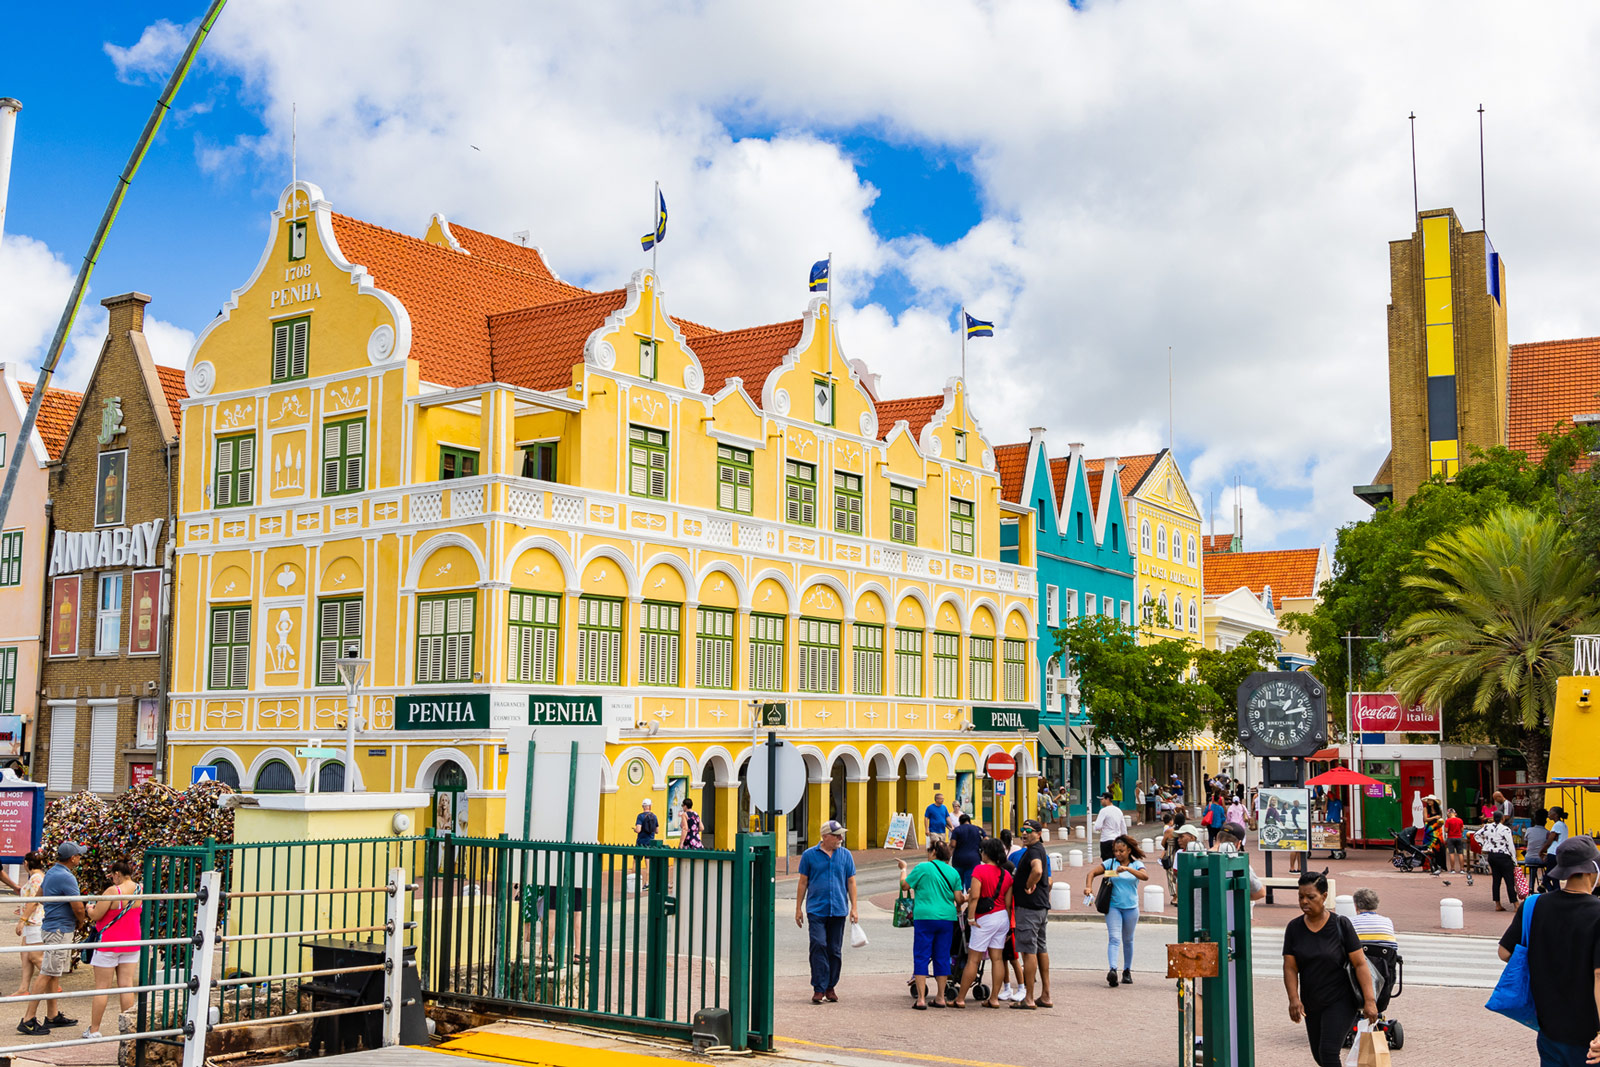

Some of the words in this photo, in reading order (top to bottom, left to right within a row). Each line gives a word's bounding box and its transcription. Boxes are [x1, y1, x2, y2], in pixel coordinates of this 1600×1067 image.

[284, 263, 312, 282] 1708
[270, 281, 322, 309] PENHA
[48, 518, 165, 577] ANNABAY
[1141, 562, 1150, 575] LA
[1151, 565, 1168, 581] CASA
[1169, 570, 1199, 588] AMARILLA
[1266, 691, 1271, 700] 11
[1277, 688, 1285, 696] 12
[1258, 700, 1266, 708] 10
[1297, 699, 1304, 707] 2
[408, 701, 476, 723] PENHA
[533, 701, 598, 722] PENHA
[1254, 710, 1260, 719] 9
[1301, 710, 1308, 718] 3
[991, 712, 1023, 727] PENHA
[1406, 713, 1434, 722] Italia
[1258, 722, 1264, 730] 8
[1268, 730, 1274, 738] 7
[1279, 732, 1284, 740] 6
